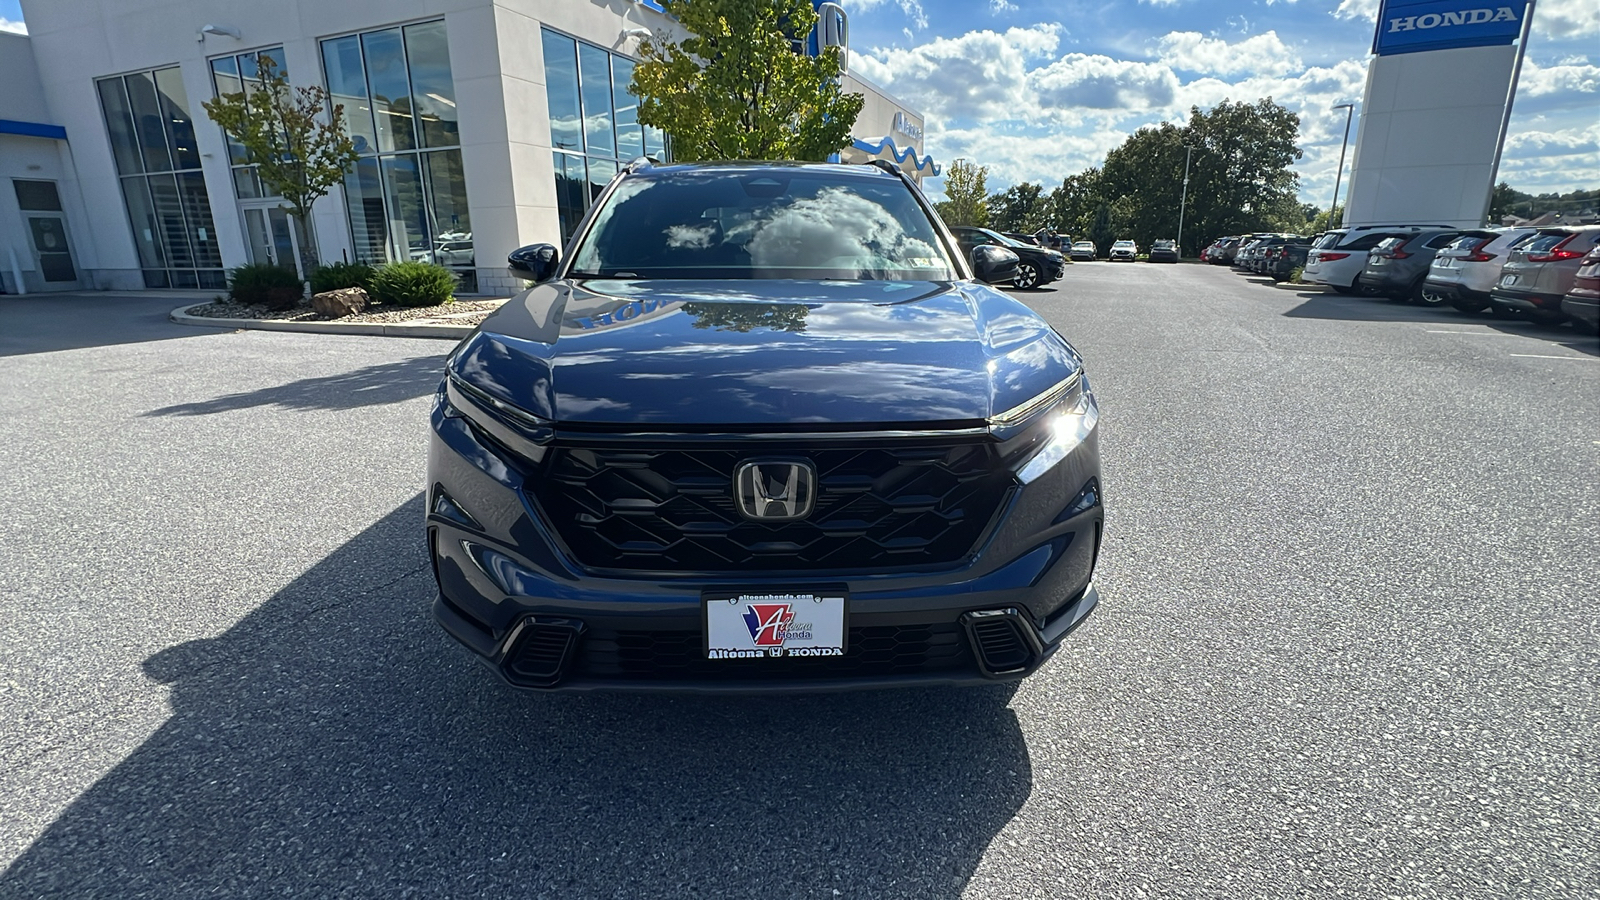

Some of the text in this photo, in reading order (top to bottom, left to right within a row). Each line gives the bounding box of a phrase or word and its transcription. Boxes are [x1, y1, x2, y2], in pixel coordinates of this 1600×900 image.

[1388, 7, 1518, 33] HONDA
[778, 631, 812, 640] Honda
[708, 649, 765, 659] Altoona
[788, 648, 844, 657] HONDA
